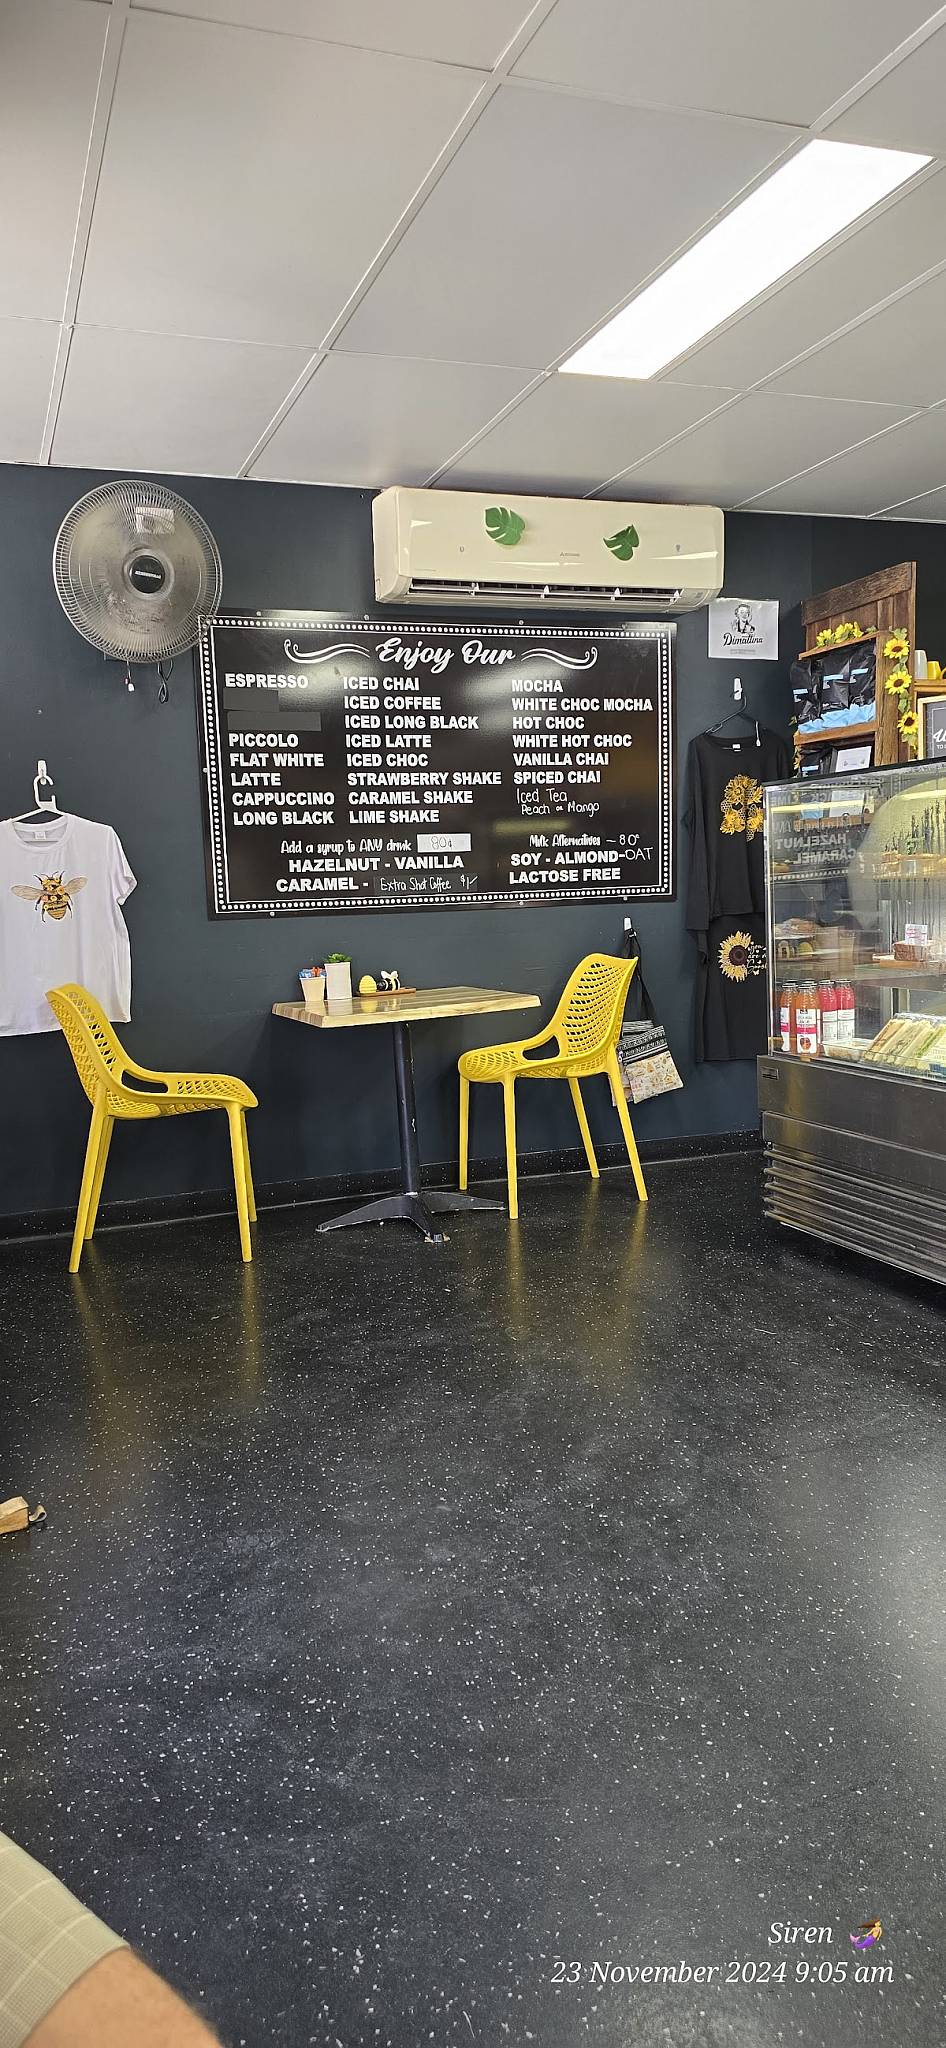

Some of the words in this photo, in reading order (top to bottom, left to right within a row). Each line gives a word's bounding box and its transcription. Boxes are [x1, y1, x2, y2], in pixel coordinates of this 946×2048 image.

[376, 638, 454, 673] Enjoy
[461, 640, 515, 665] Our
[225, 674, 308, 689] ESPRESSO
[343, 677, 379, 691] ICED
[383, 677, 420, 691] CHAI
[511, 679, 563, 692] MOCHA
[344, 695, 380, 709] ICED
[384, 695, 441, 710] COFFEE
[511, 698, 558, 711] WHITE
[560, 698, 600, 711] CHOC
[603, 698, 653, 711] MOCHA
[345, 715, 381, 729] ICED
[385, 715, 426, 729] LONG
[429, 715, 478, 729] BLACK
[512, 717, 543, 730] HOT
[545, 717, 585, 730] CHOC
[228, 733, 299, 748] PICCOLO
[345, 734, 381, 748] ICED
[385, 734, 432, 748] LATTE
[512, 735, 558, 748] WHITE
[560, 735, 589, 748] HOT
[592, 735, 632, 747] CHOC
[230, 752, 270, 767] FLAT
[273, 752, 324, 767] WHITE
[346, 753, 382, 767] ICED
[386, 753, 428, 767] CHOC
[513, 753, 572, 766] VANILLA
[574, 753, 609, 766] CHAI
[231, 772, 281, 787] LATTE
[347, 772, 451, 787] STRAWBERRY
[452, 771, 502, 786] SHAKE
[513, 771, 563, 784] SPICED
[567, 771, 601, 784] CHAI
[231, 791, 335, 806] CAPPUCCINO
[348, 791, 420, 805] CARAMEL
[423, 790, 473, 804] SHAKE
[516, 788, 539, 803] Iced
[546, 787, 567, 802] Tea
[349, 810, 385, 824] LIME
[388, 809, 440, 823] SHAKE
[521, 804, 550, 815] Peach
[233, 811, 277, 825] LONG
[280, 810, 335, 825] BLACK
[281, 840, 302, 854] Add
[306, 845, 314, 854] a
[317, 842, 344, 856] syrup
[347, 840, 356, 852] to
[359, 838, 383, 852] ANY
[387, 838, 412, 852] drink
[529, 835, 549, 847] Milk
[552, 834, 600, 846] Alternatives
[289, 857, 381, 873] HAZELNUT
[394, 856, 464, 870] VANILLA
[510, 852, 542, 866] SOY
[380, 878, 407, 891] Extra
[409, 877, 426, 890] Shot
[429, 876, 452, 891] Coffee
[509, 870, 578, 884] LACTOSE
[583, 868, 621, 881] FREE
[276, 877, 359, 892] CARAMEL
